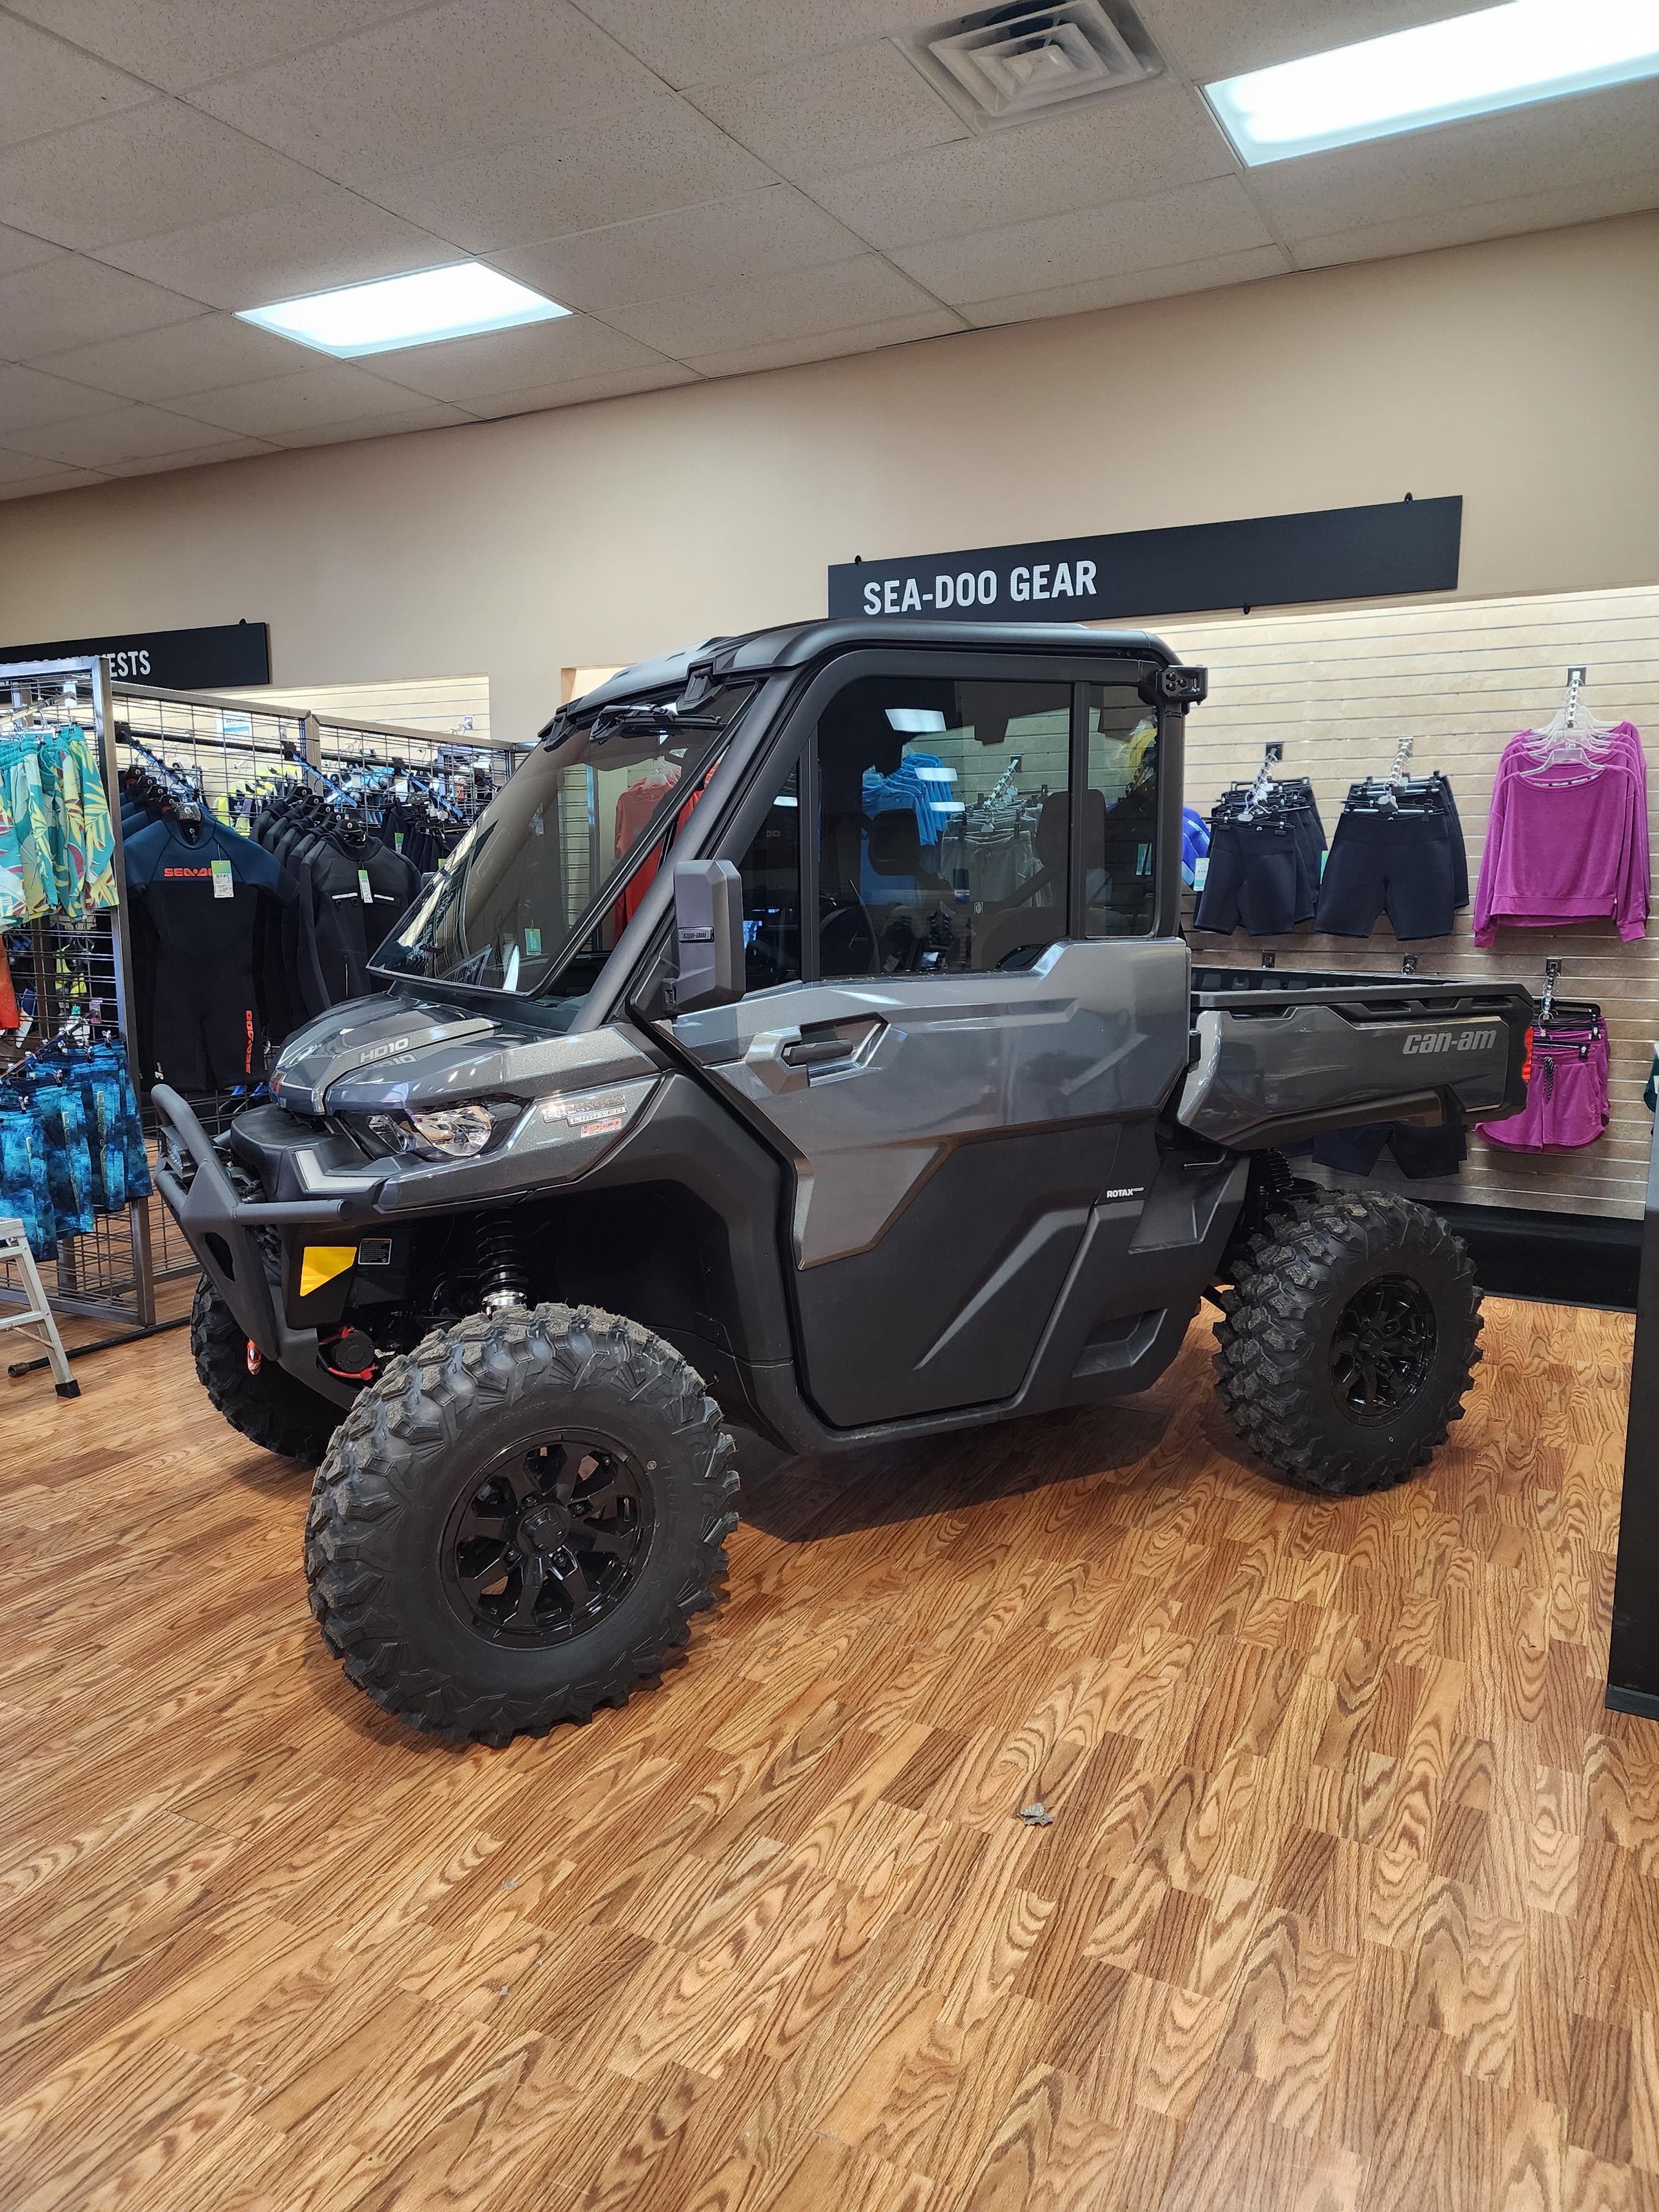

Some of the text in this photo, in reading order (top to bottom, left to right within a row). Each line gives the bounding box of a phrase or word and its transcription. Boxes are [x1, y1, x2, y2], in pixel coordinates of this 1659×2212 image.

[863, 560, 1097, 615] SEA-DOO GEAR
[102, 650, 151, 677] ESTS
[360, 1037, 409, 1063] HD10
[1402, 1030, 1497, 1055] can-am
[581, 1118, 622, 1135] HEXCO
[1107, 1188, 1134, 1198] ROTAX
